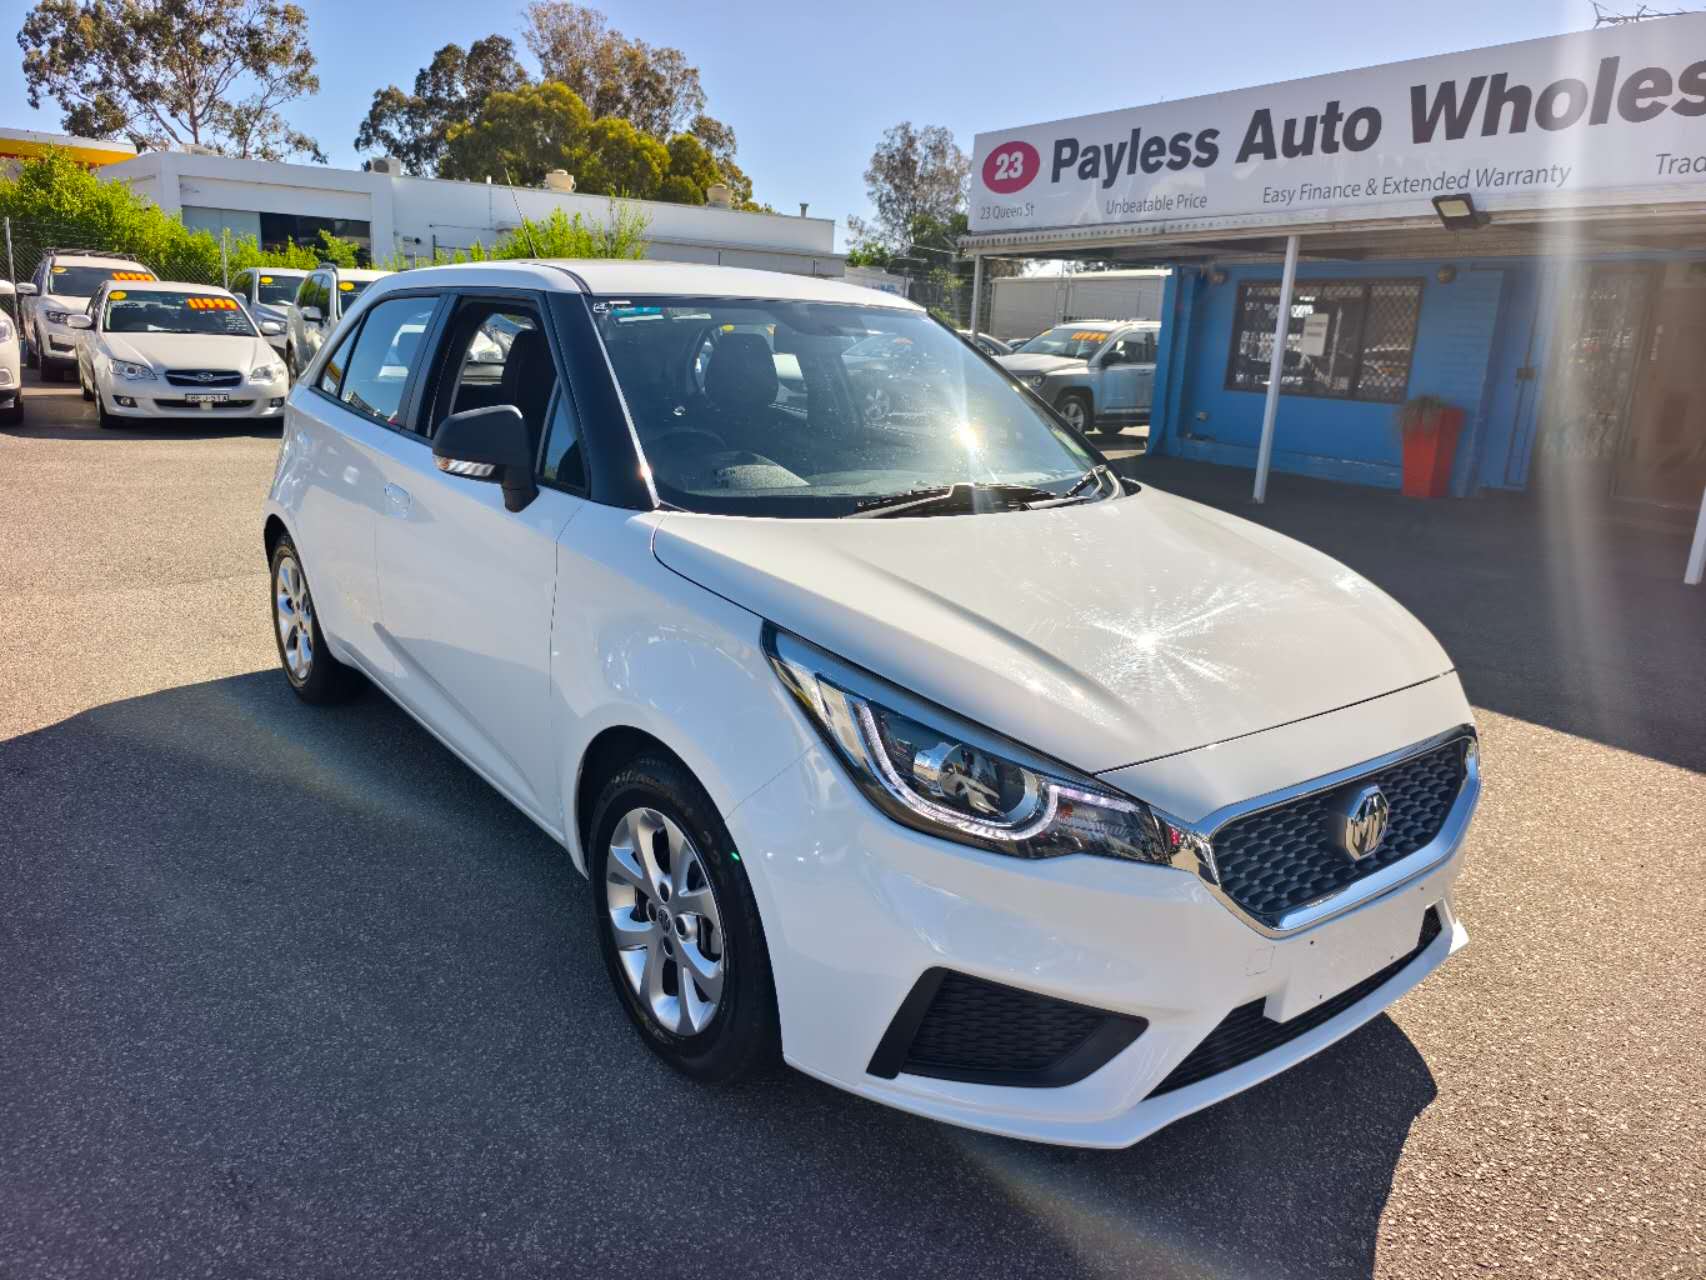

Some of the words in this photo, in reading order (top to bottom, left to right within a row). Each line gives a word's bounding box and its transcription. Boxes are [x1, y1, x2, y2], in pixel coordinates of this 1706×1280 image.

[1051, 128, 1220, 191] Payless
[1235, 100, 1381, 163] Auto
[1410, 55, 1706, 144] Wholes
[994, 151, 1024, 181] 23
[1263, 184, 1297, 207] Easy
[1301, 181, 1361, 201] Finance
[1364, 179, 1378, 196] &
[1383, 169, 1470, 195] Extended
[1475, 165, 1571, 190] Warranty
[980, 205, 992, 220] 23
[992, 205, 1023, 220] Queen
[1024, 202, 1035, 217] St
[1106, 196, 1172, 215] Unbeatable
[1176, 193, 1208, 209] Price
